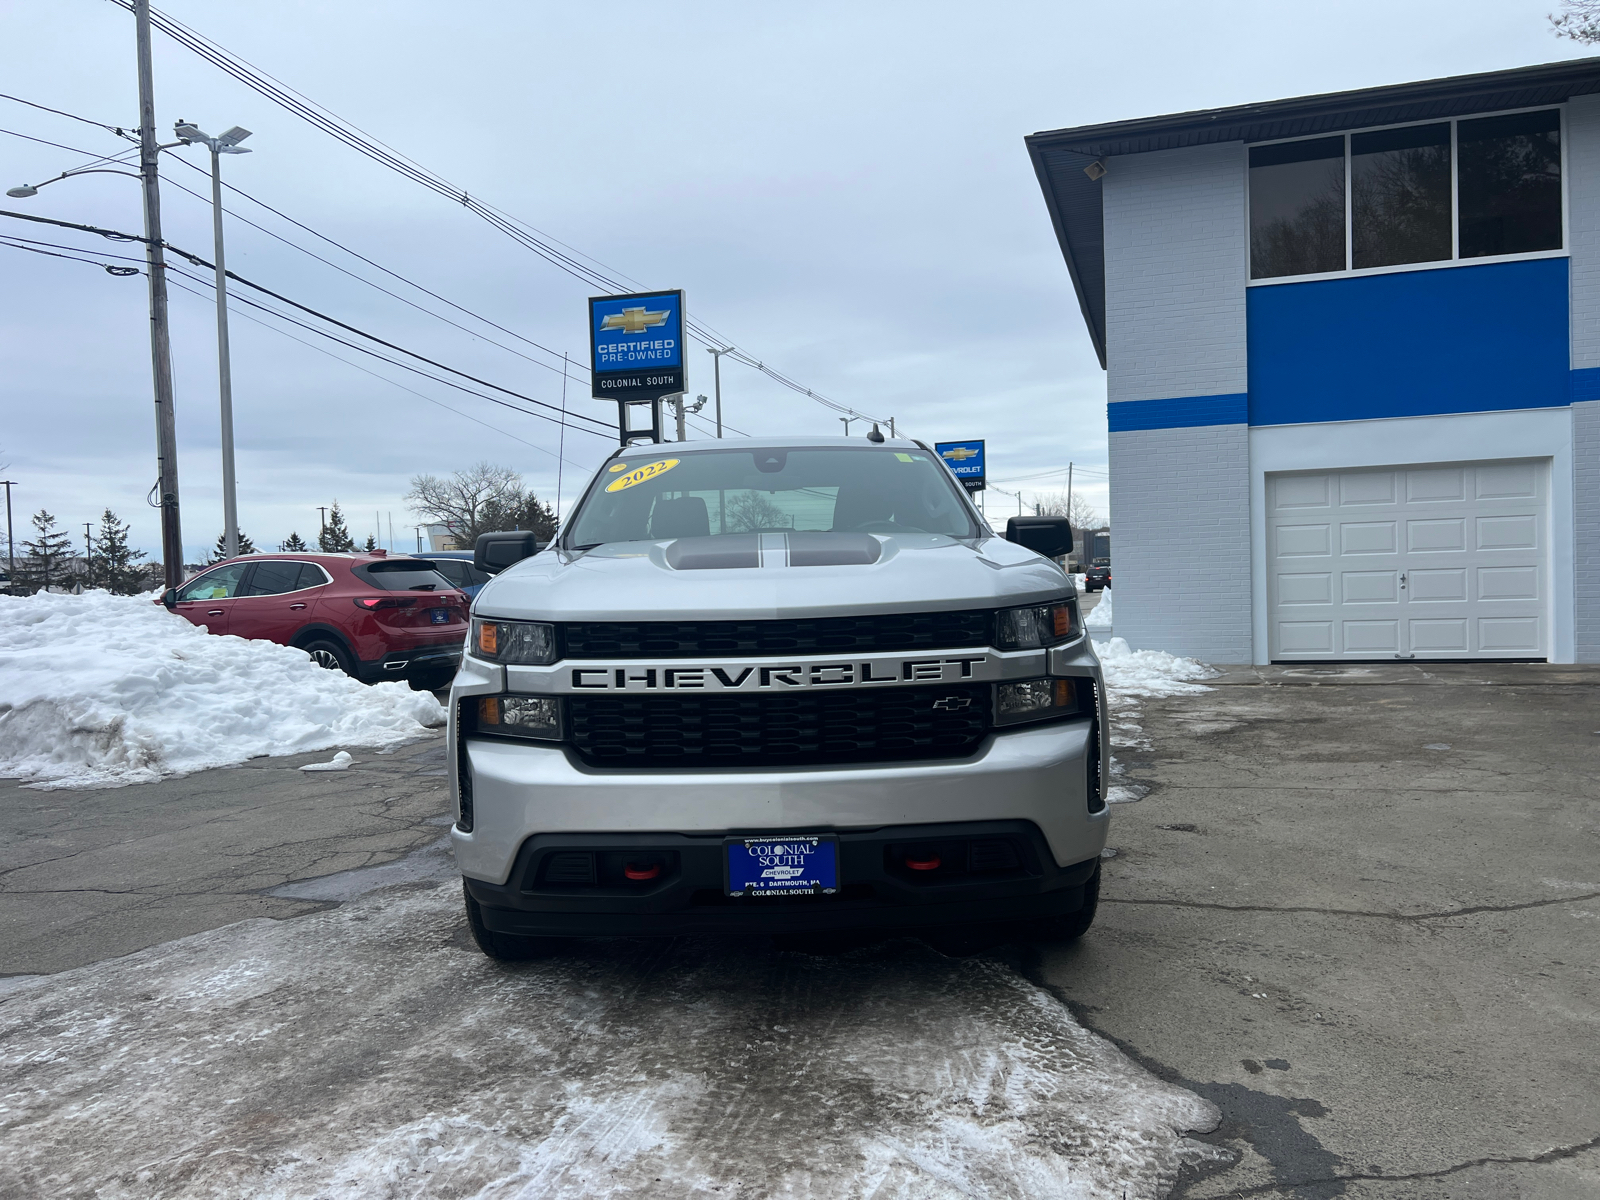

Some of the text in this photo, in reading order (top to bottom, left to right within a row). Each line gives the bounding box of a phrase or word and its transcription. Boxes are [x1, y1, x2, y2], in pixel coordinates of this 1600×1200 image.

[598, 340, 675, 353] CERTIFIED
[602, 350, 671, 362] PRE-OWNED
[601, 376, 674, 388] COLONIAL SOUTH
[621, 461, 667, 488] 2022
[950, 466, 982, 474] VROLET
[571, 656, 987, 690] CHEVROLET
[748, 844, 815, 857] COLONIAL
[759, 855, 805, 867] SOUTH
